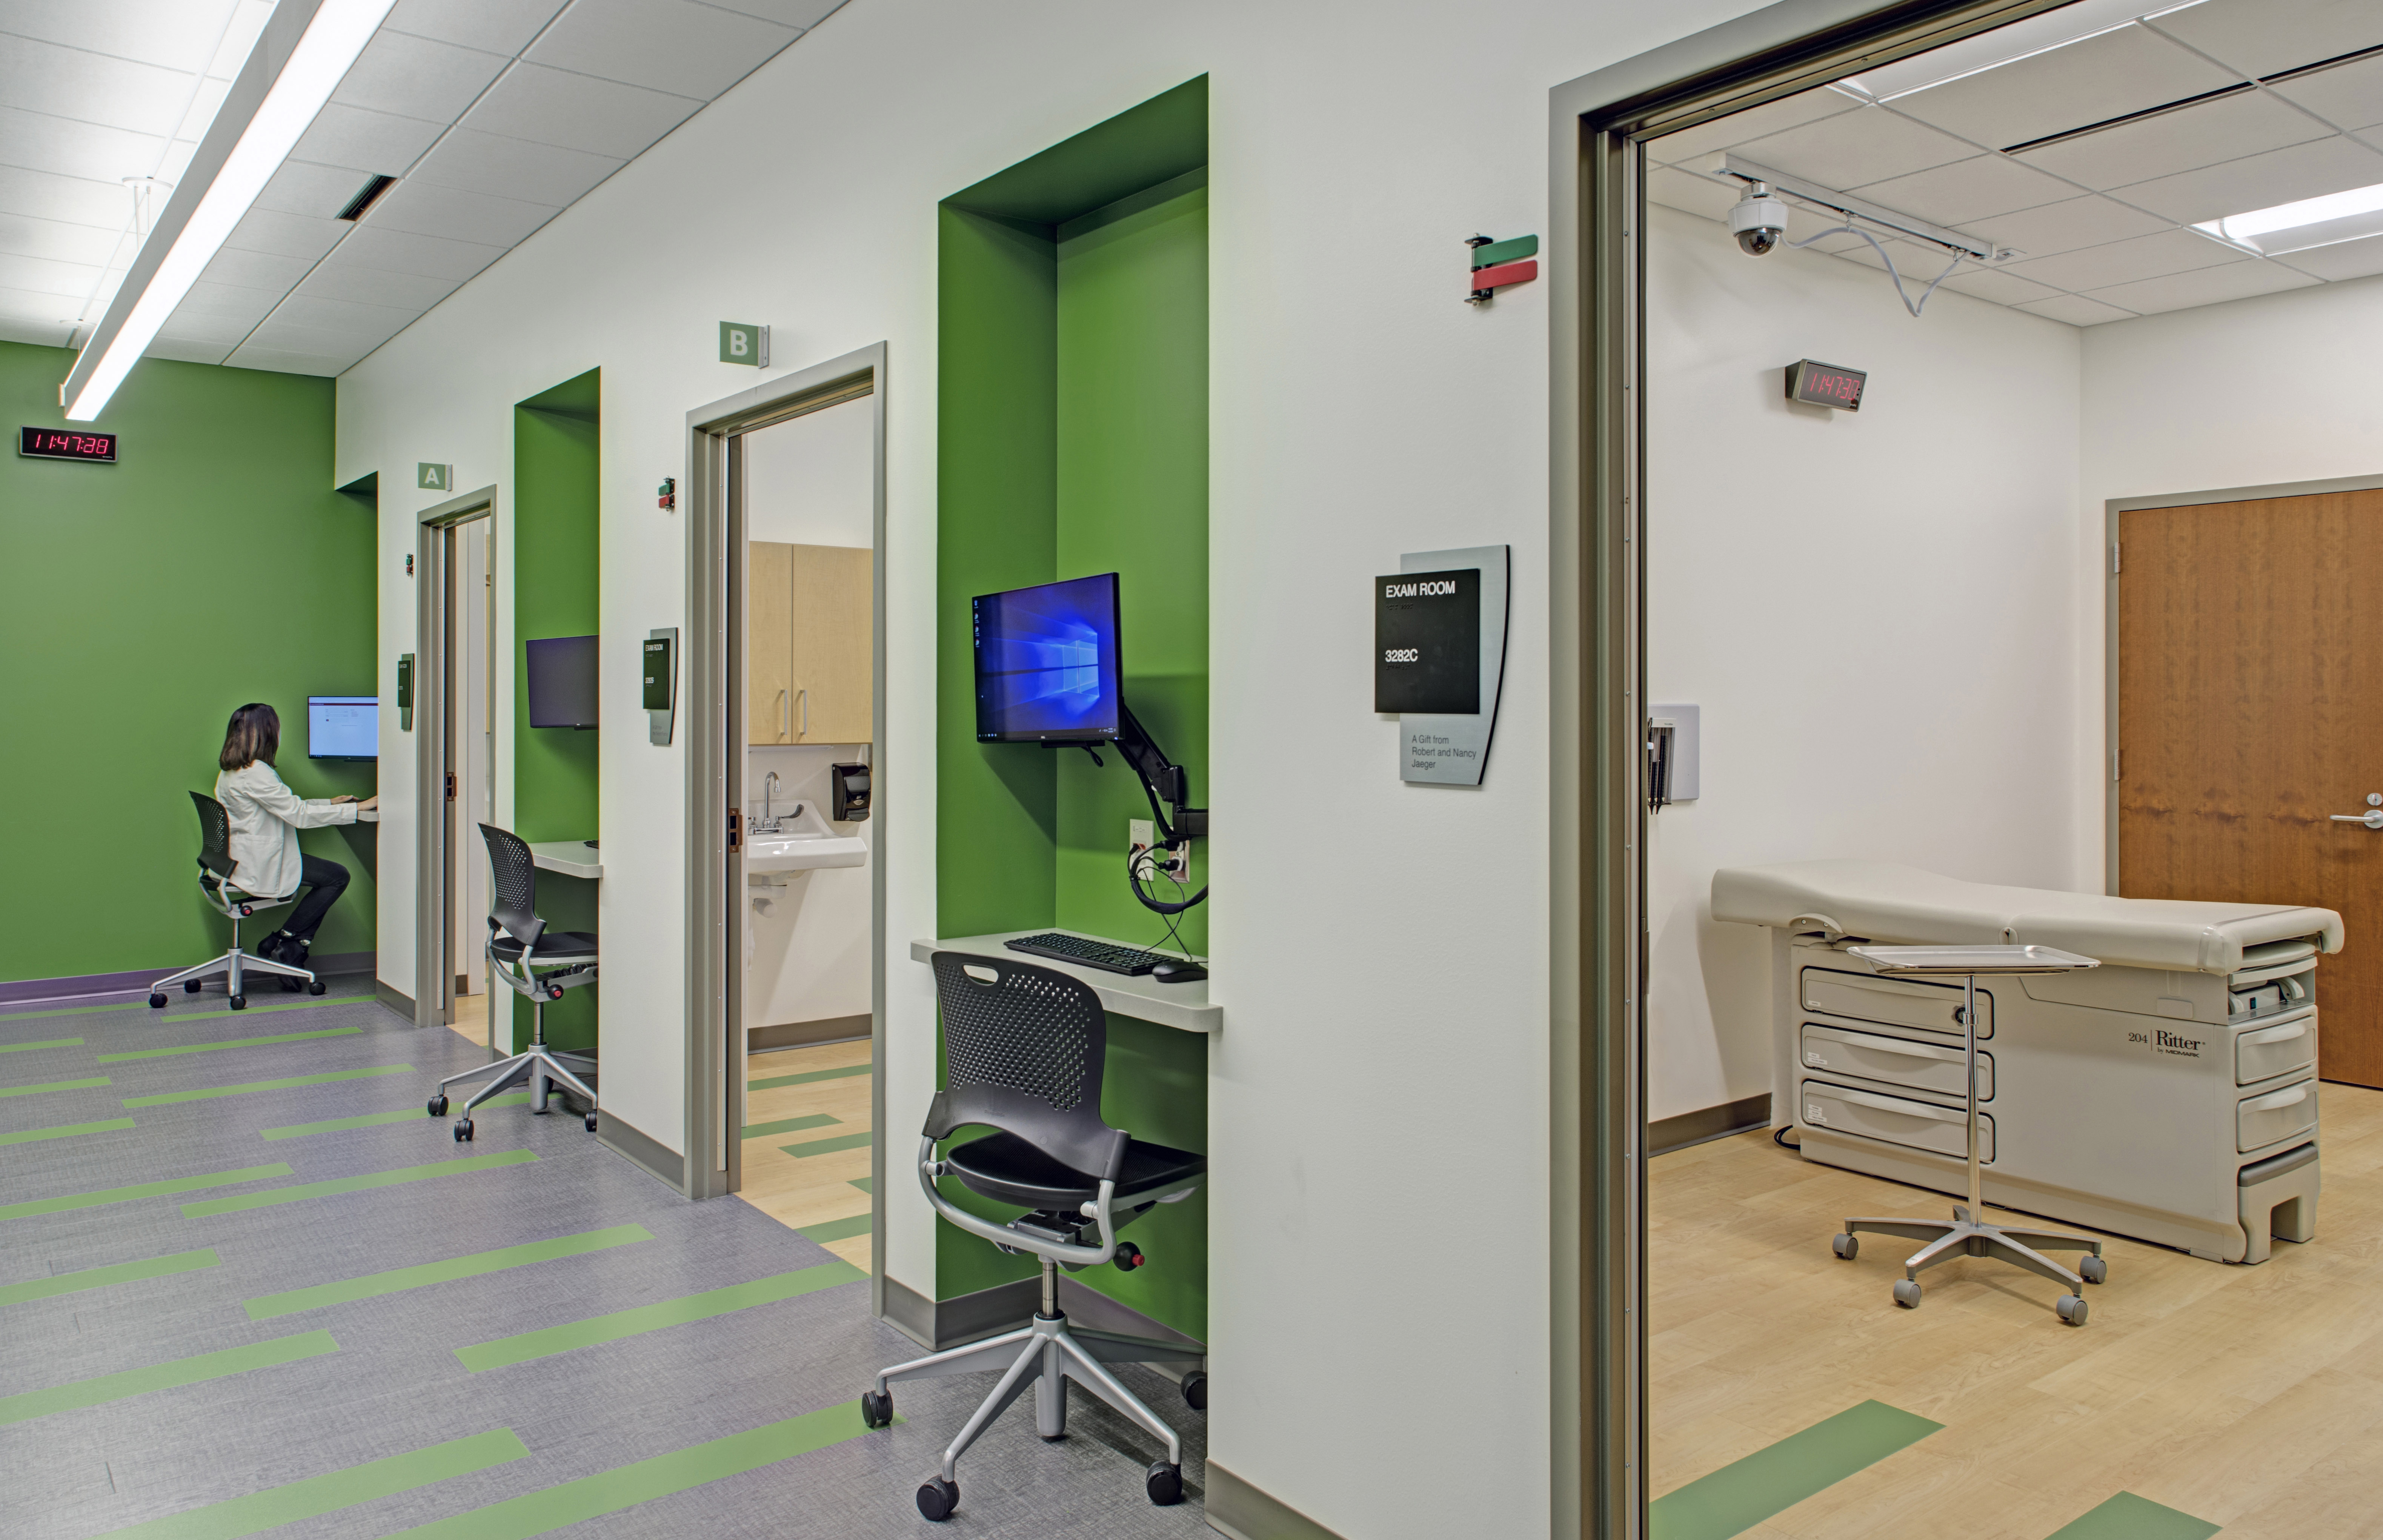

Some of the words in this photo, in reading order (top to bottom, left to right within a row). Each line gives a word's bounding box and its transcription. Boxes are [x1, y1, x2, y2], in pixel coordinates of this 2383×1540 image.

[730, 329, 748, 356] B
[424, 468, 439, 484] A
[1386, 583, 1417, 598] EXAM
[1419, 581, 1455, 596] ROOM
[1385, 649, 1418, 662] 3282C
[1412, 735, 1417, 743] A
[1419, 735, 1431, 744] Gift
[1433, 735, 1449, 744] from
[1412, 747, 1435, 756] Robert
[1437, 747, 1451, 757] and
[1453, 748, 1476, 758] Nancy
[1411, 759, 1436, 769] Jaeger
[2128, 1032, 2148, 1044] 204
[2155, 1030, 2200, 1050] Ritter
[2166, 1049, 2199, 1058] MIDMARK
